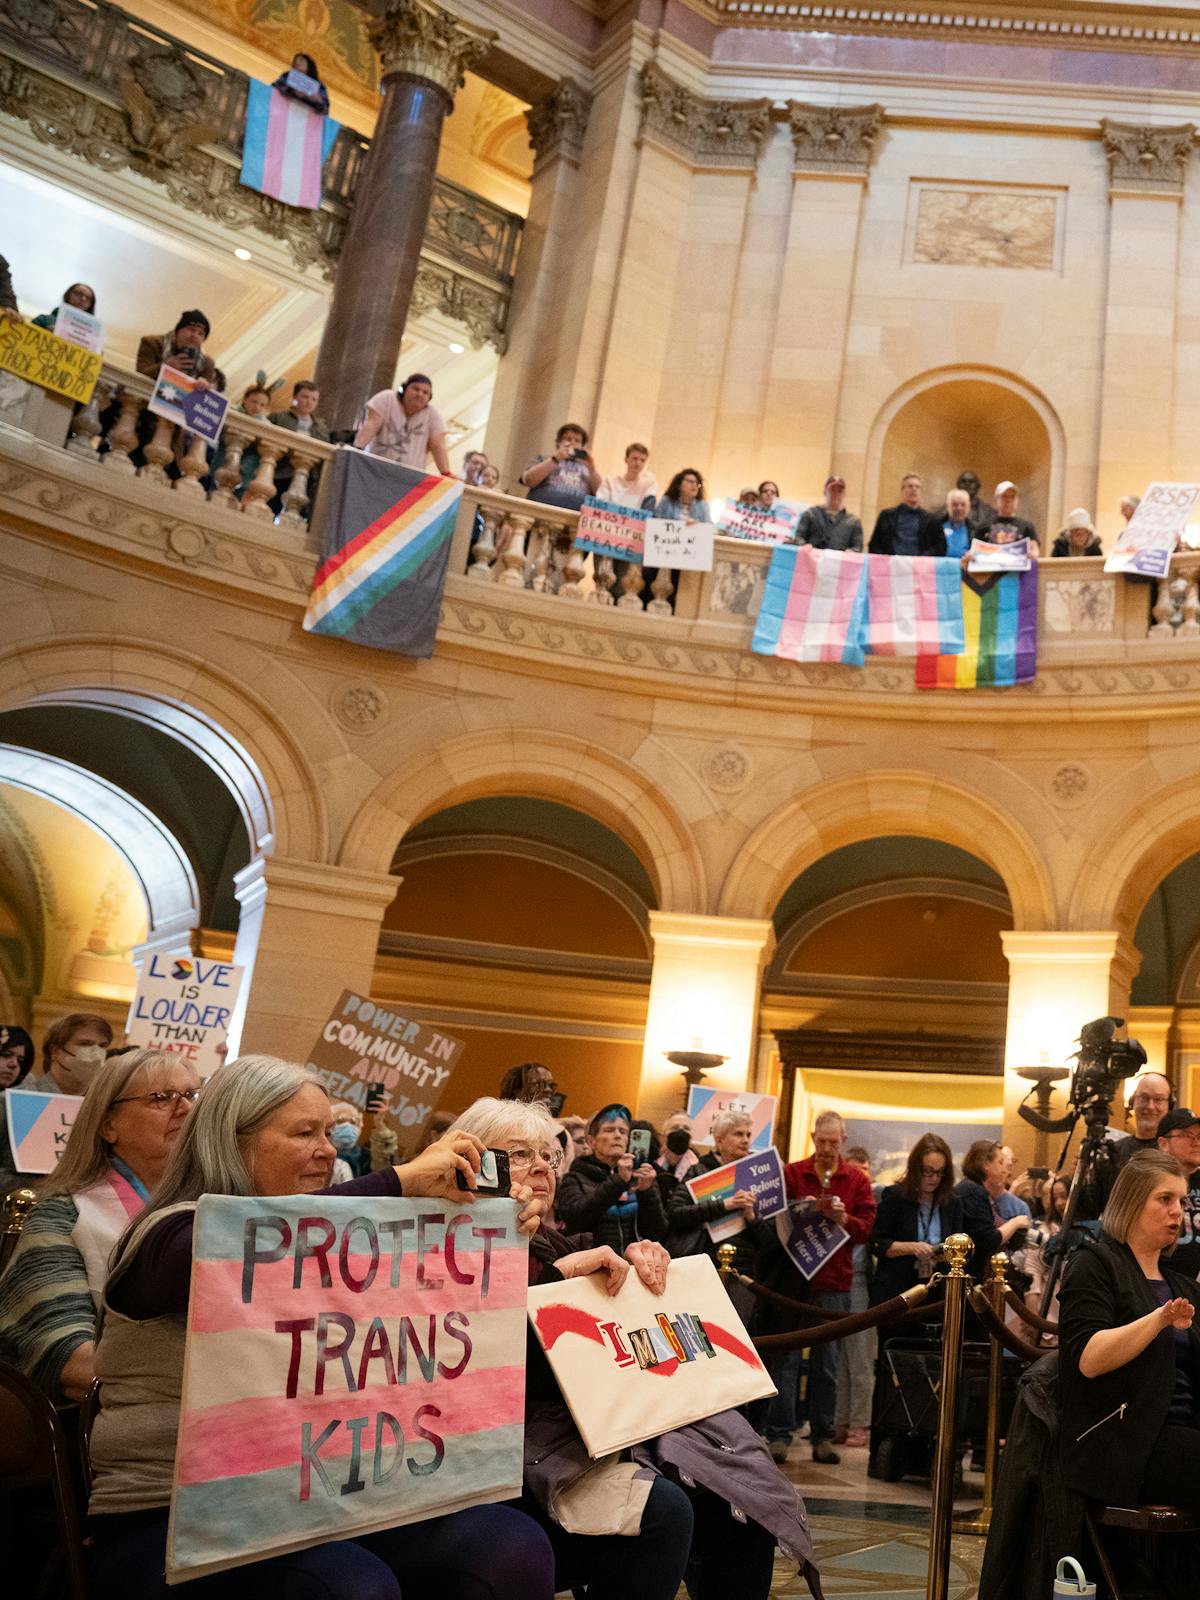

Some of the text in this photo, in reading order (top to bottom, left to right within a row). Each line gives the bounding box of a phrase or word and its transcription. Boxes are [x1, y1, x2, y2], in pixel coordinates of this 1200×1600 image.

[592, 511, 629, 526] MOST
[631, 507, 649, 520] MY
[581, 517, 644, 541] BEAUTIFUL
[180, 984, 200, 999] IS
[136, 996, 230, 1030] LOUDER
[152, 1023, 207, 1043] THAN
[342, 994, 457, 1061] POWER IN
[147, 1041, 201, 1060] HATE
[323, 1020, 450, 1087] COMMUNITY
[350, 1058, 400, 1089] AND
[389, 1094, 433, 1126] JOY
[718, 1101, 747, 1111] LET
[749, 1162, 771, 1177] You
[750, 1177, 780, 1196] Belong
[758, 1195, 779, 1211] Here
[803, 1224, 828, 1258] Belong
[818, 1219, 833, 1240] You
[242, 1213, 507, 1303] PROTECT
[794, 1241, 814, 1264] Here
[597, 1311, 717, 1370] IMAGINE
[275, 1311, 472, 1399] TRANS
[299, 1404, 445, 1501] KIDS
